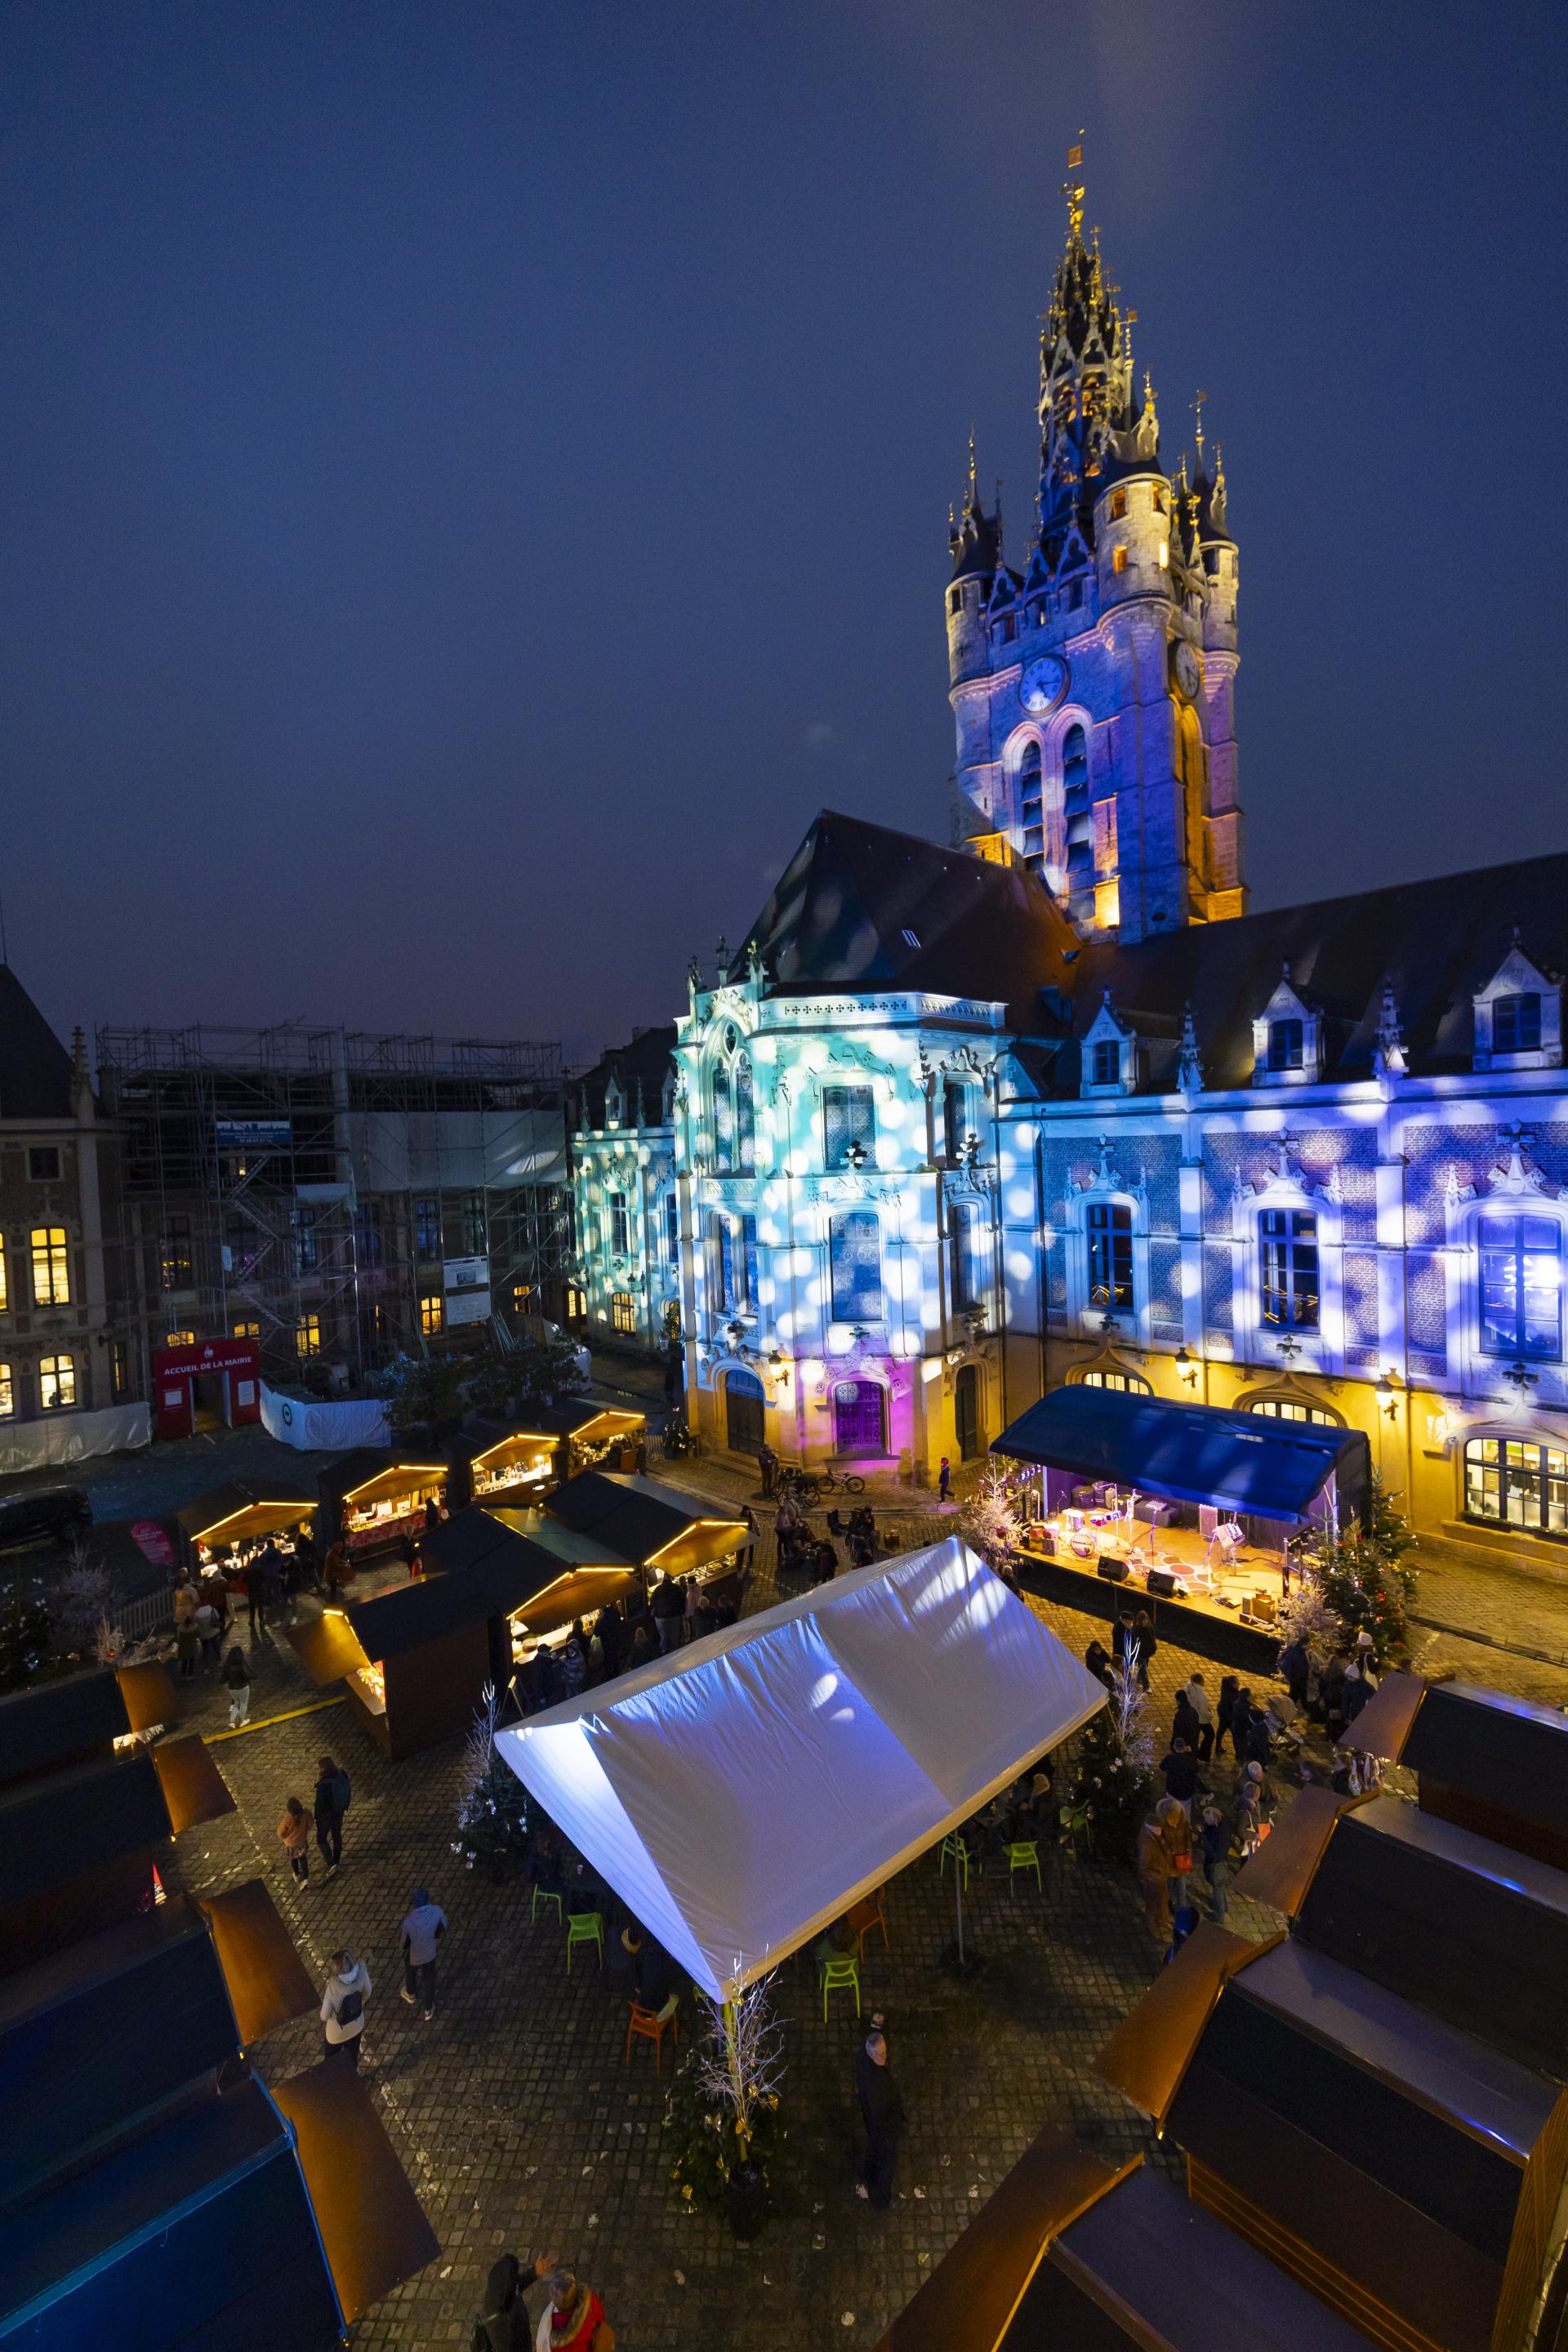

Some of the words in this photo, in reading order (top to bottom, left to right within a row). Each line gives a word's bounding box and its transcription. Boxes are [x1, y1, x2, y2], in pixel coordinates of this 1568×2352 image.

[164, 1365, 198, 1375] ACCUEIL
[200, 1362, 212, 1370] DE
[225, 1356, 252, 1365] MAIRIE
